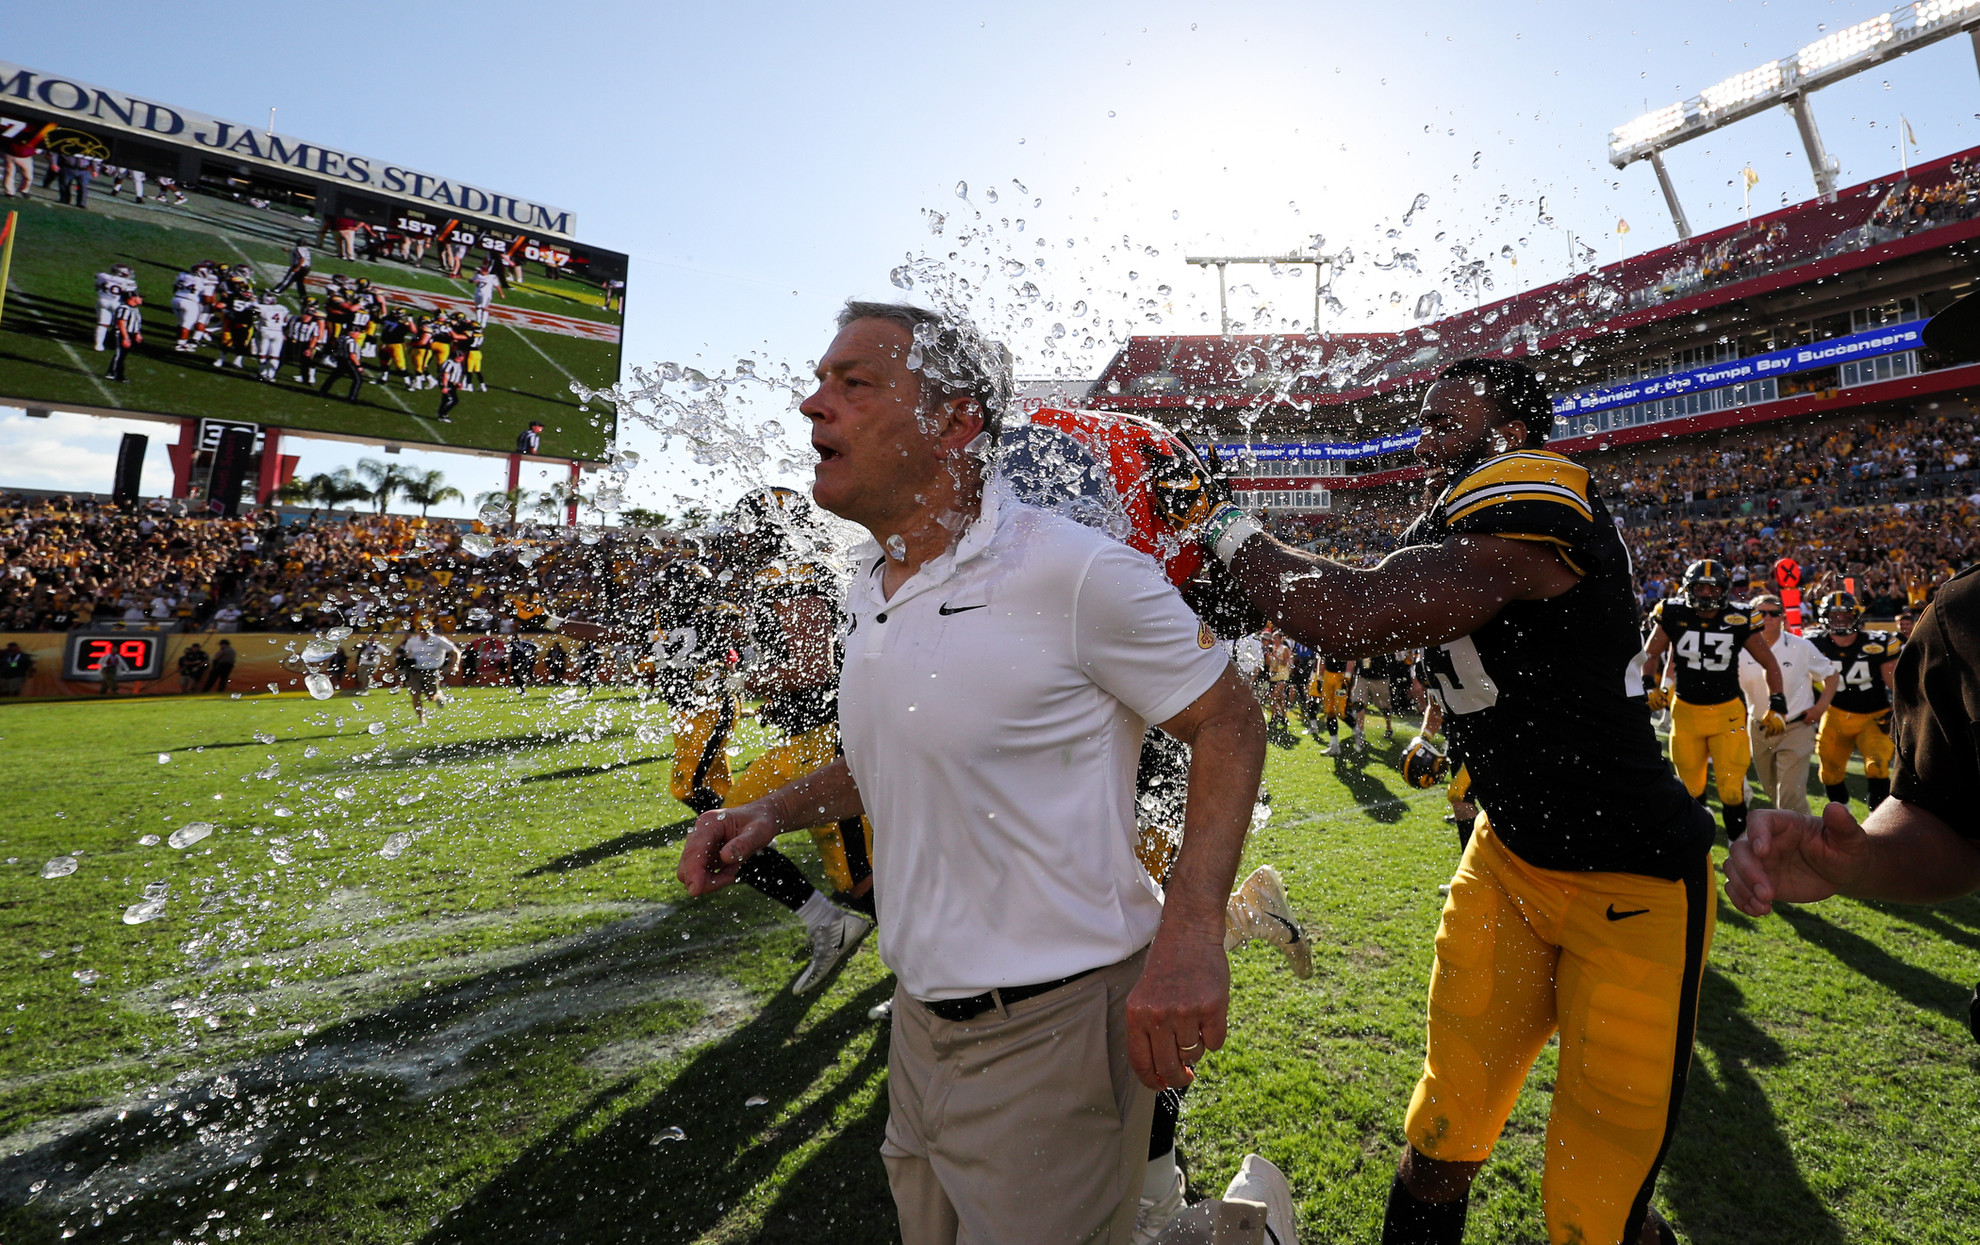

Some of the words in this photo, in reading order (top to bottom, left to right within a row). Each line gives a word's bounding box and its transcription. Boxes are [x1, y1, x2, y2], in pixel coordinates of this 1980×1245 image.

[194, 120, 370, 183] JAMES
[382, 167, 571, 235] STADIUM
[397, 217, 437, 236] 1ST
[451, 230, 475, 245] 10
[482, 237, 507, 252] 32
[524, 246, 570, 267] 0:17
[1580, 389, 1640, 410] Sponsor
[1644, 382, 1660, 395] of
[1664, 377, 1692, 391] the
[1696, 365, 1751, 385] Tampa
[1756, 356, 1792, 372] Bay
[1797, 330, 1918, 364] Buccaneers
[1288, 447, 1300, 456] of
[1303, 448, 1322, 457] the
[1326, 447, 1360, 457] Tampa
[87, 640, 146, 670] 39
[1676, 630, 1734, 671] 43
